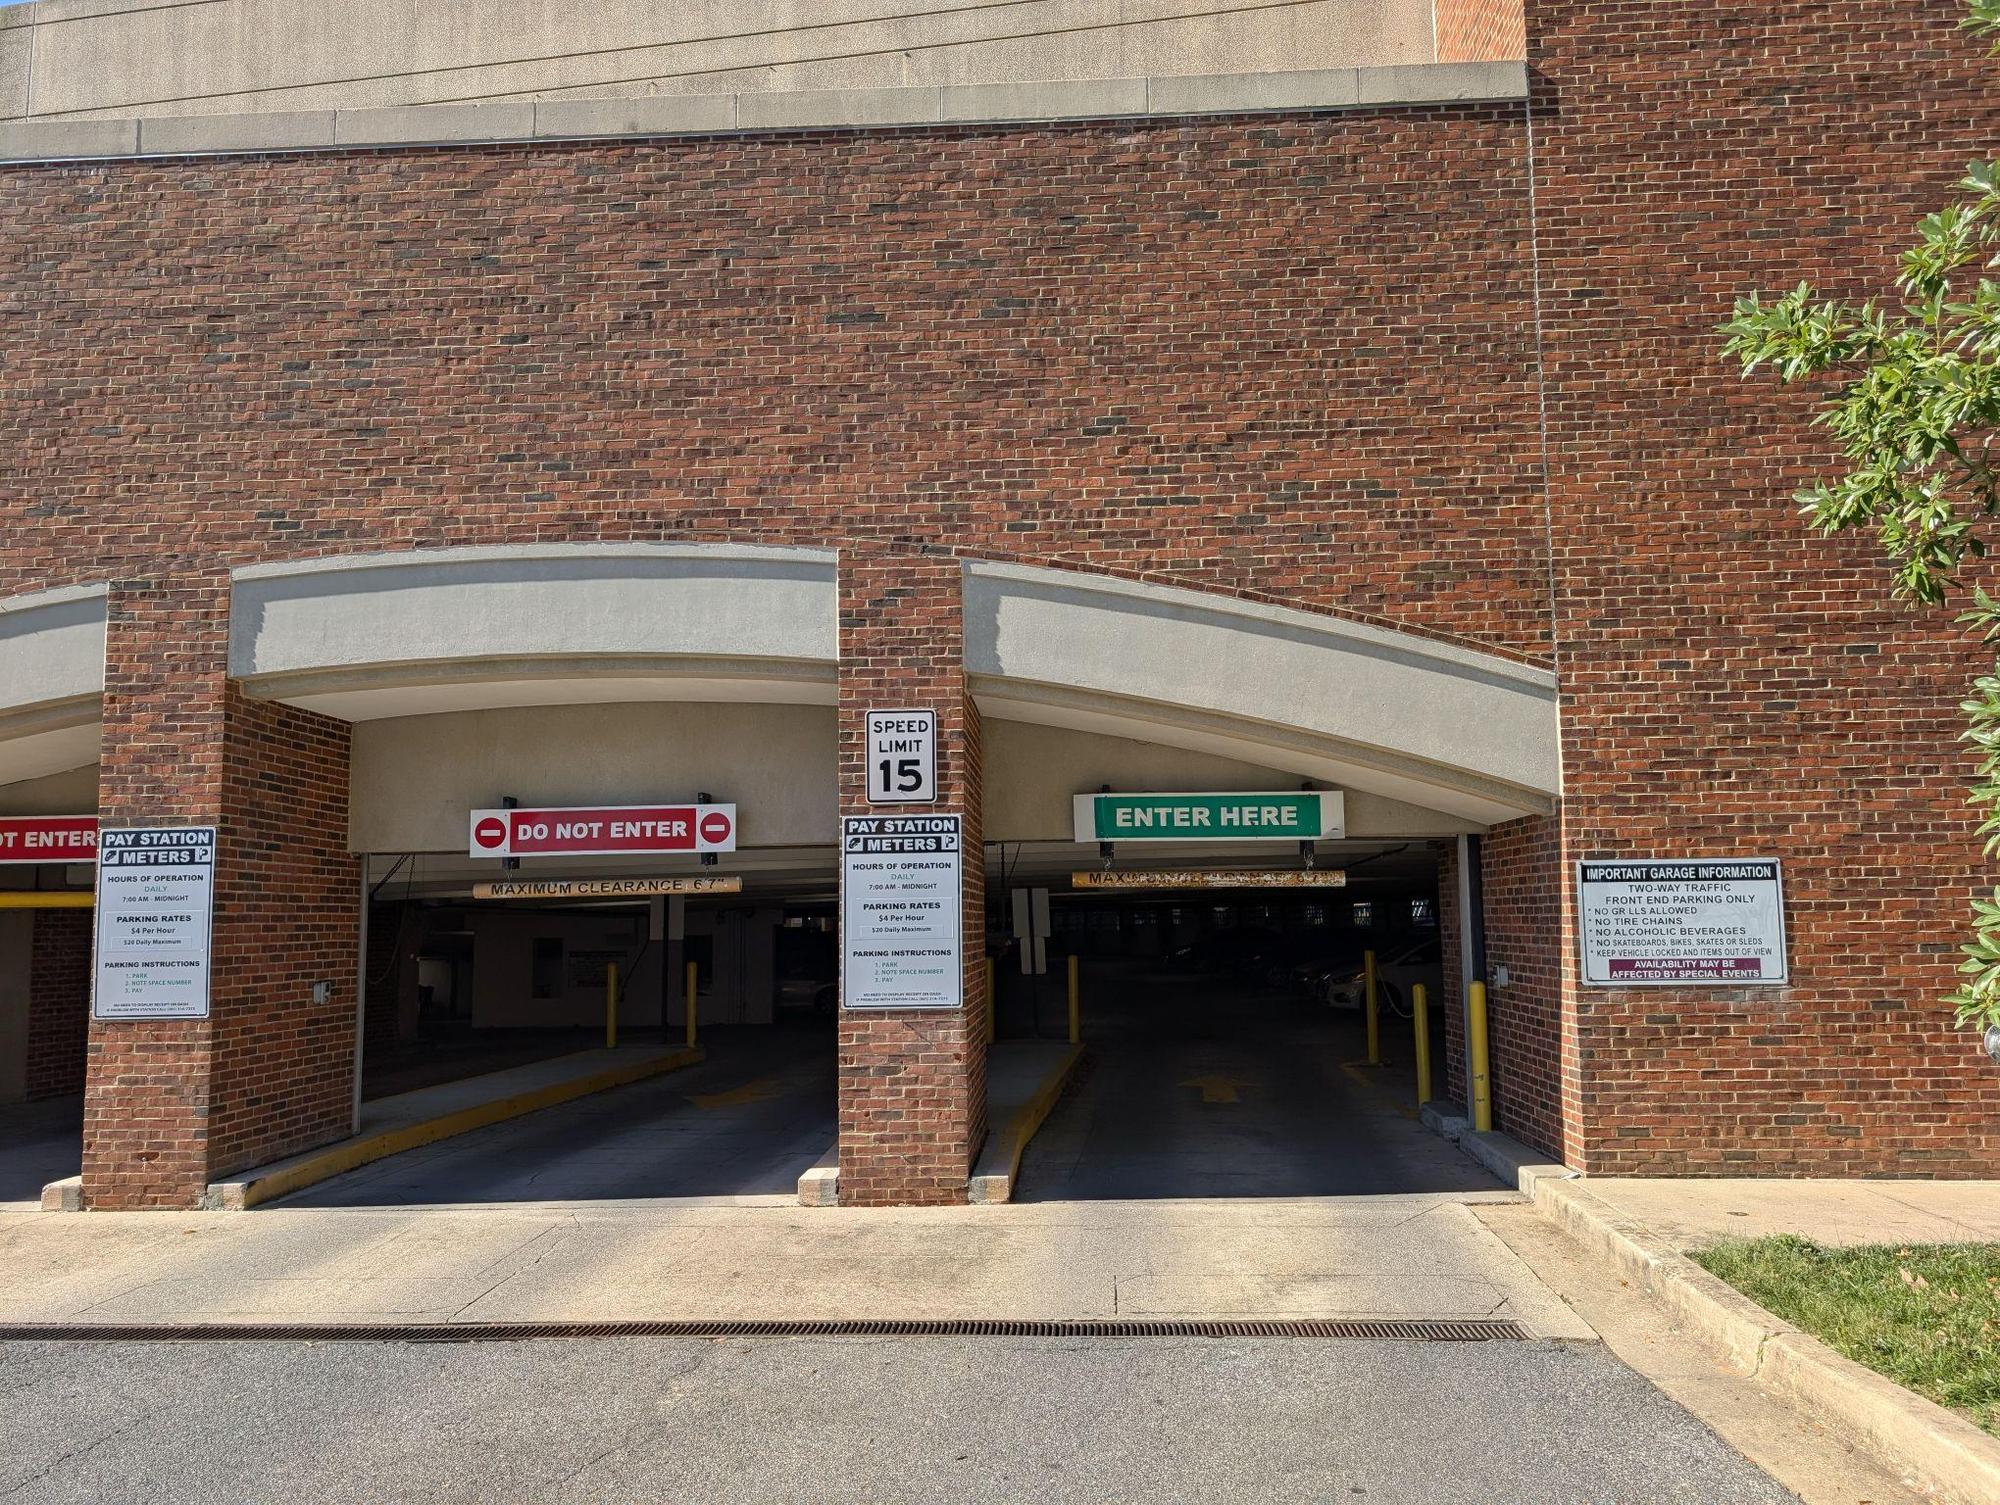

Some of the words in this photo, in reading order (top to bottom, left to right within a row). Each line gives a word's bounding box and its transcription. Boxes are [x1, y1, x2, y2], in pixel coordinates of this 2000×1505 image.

[873, 720, 929, 734] SPEED
[878, 739, 923, 753] LIMIT
[879, 759, 923, 793] 15
[1116, 806, 1211, 828] ENTER
[1220, 805, 1298, 826] HERE
[517, 823, 549, 841] DO
[555, 822, 603, 840] NOT
[610, 820, 688, 839] ENTER
[848, 820, 880, 833] PAY
[884, 819, 955, 832] STATION
[24, 830, 97, 848] ENTER
[105, 833, 136, 846] PAY
[140, 832, 210, 845] STATION
[867, 838, 937, 851] METERS
[122, 851, 191, 864] METERS
[853, 863, 883, 871] HOURS
[900, 862, 952, 870] OPERATION
[154, 874, 204, 882] OPERATION
[1586, 867, 1648, 880] IMPORTANT
[1650, 867, 1696, 879] GARAGE
[1698, 866, 1772, 879] INFORMATION
[491, 881, 572, 895] MAXIMUM
[578, 880, 683, 894] CLEARANCE
[1628, 884, 1681, 893] TWO-WAY
[1684, 883, 1731, 892] TRAFFIC
[1605, 896, 1643, 905] FRONT
[1646, 896, 1669, 904] END
[1672, 895, 1722, 904] PARKING
[1726, 894, 1755, 904] ONLY
[1649, 906, 1697, 915] ALLOWED
[879, 914, 888, 922] $4
[1595, 918, 1611, 926] NO
[1614, 918, 1638, 926] TIRE
[1641, 917, 1683, 925] CHAINS
[131, 927, 140, 935] $4
[1595, 928, 1611, 936] NO
[1614, 928, 1676, 936] ALCOHOLIC
[1680, 927, 1746, 935] BEVERAGES
[1696, 938, 1724, 946] SKATES
[891, 949, 952, 957] INSTRUCTIONS
[1596, 949, 1616, 957] KEEP
[1617, 949, 1649, 957] VEHICLE
[1652, 948, 1681, 957] LOCKED
[1683, 948, 1698, 956] AND
[1700, 948, 1722, 956] ITEMS
[1754, 947, 1772, 955] VIEW
[141, 960, 200, 968] INSTRUCTIONS
[1634, 960, 1697, 968] AVAILABILITY
[1700, 959, 1722, 968] MAY
[1722, 959, 1735, 967] BE
[1611, 970, 1661, 979] AFFECTED
[1663, 970, 1678, 978] BY
[1679, 970, 1720, 978] SPECIAL
[1722, 969, 1760, 977] EVENTS
